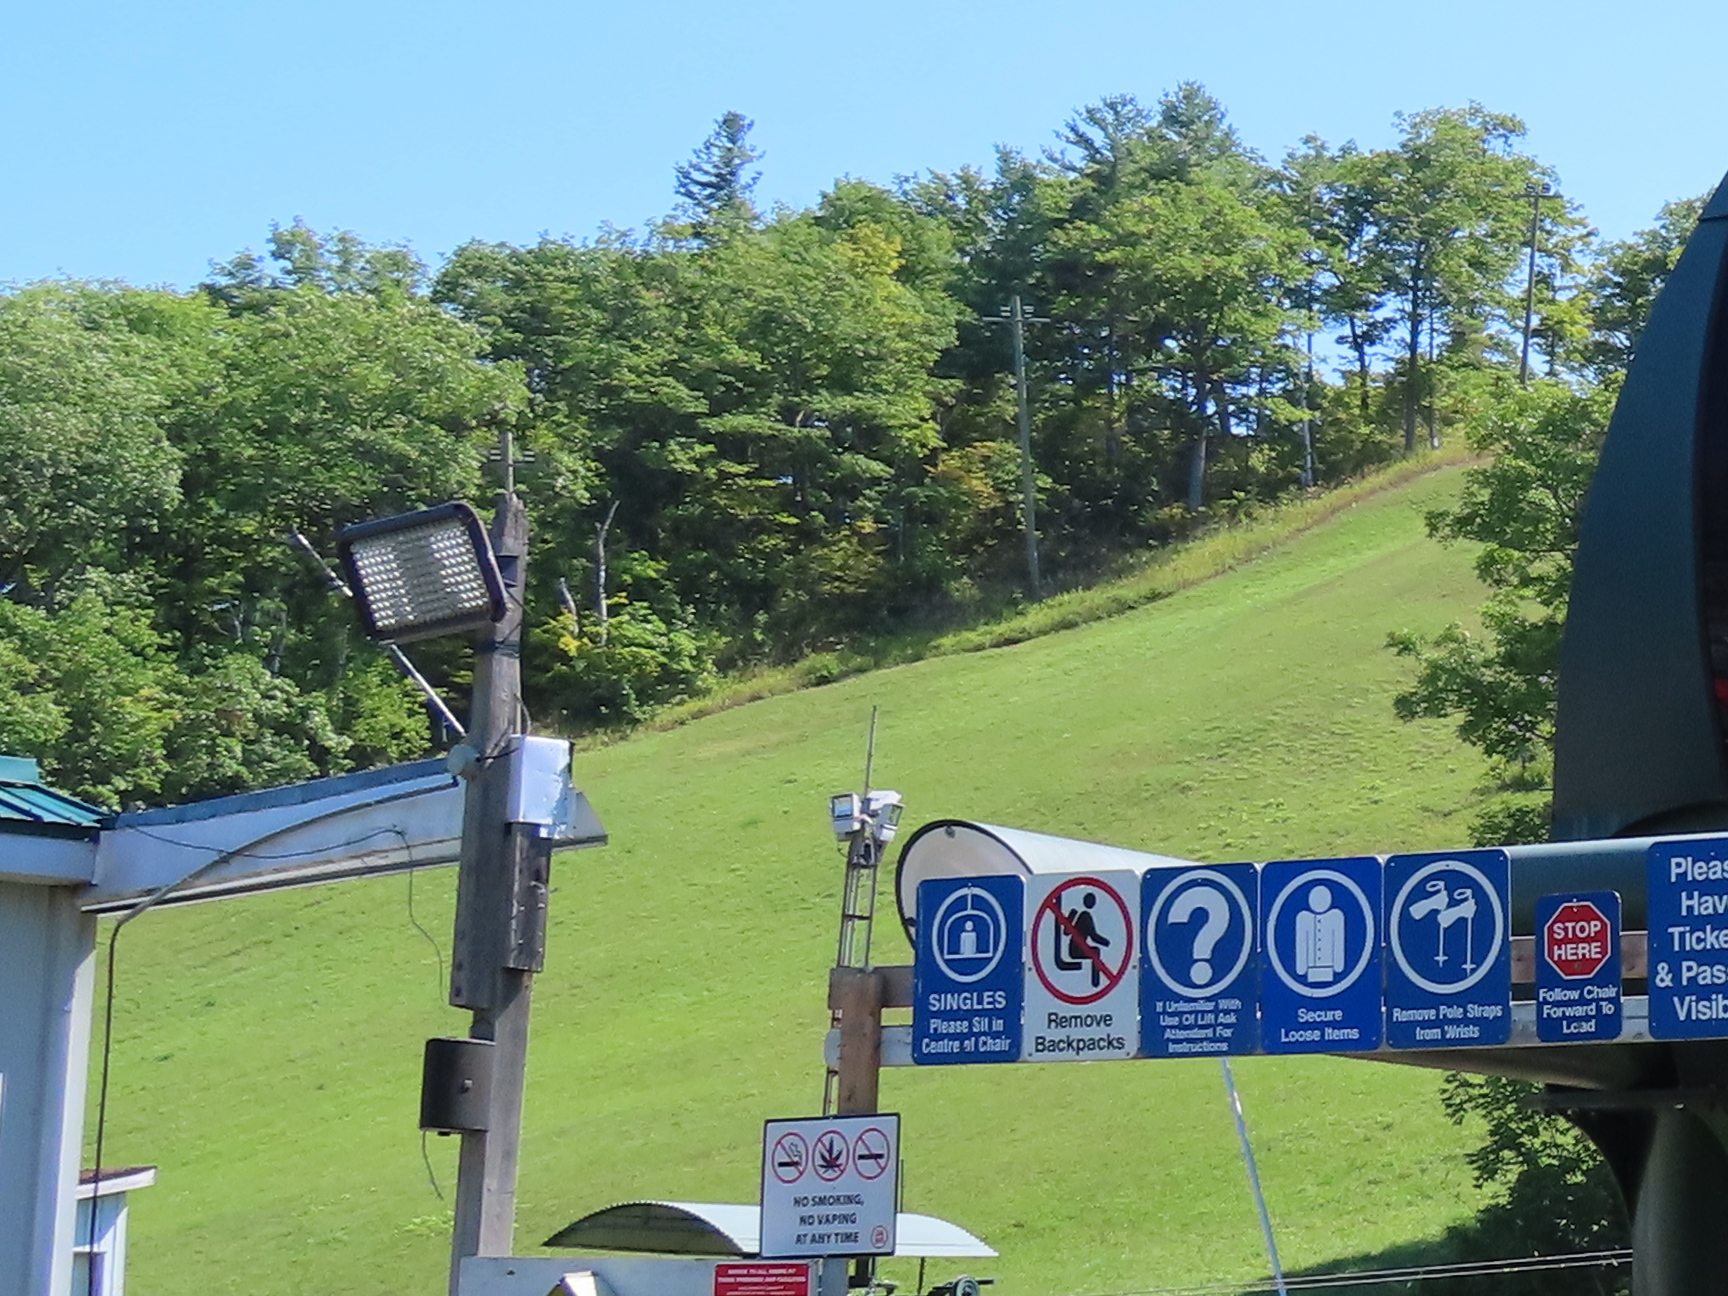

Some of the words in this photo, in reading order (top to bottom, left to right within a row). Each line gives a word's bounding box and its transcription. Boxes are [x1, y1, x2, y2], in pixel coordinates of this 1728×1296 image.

[1553, 921, 1601, 939] STOP
[1553, 942, 1602, 961] HERE
[1655, 962, 1673, 988] &
[928, 991, 1007, 1011] SINGLES
[1539, 988, 1579, 1002] Follow
[1583, 984, 1618, 1000] Chair
[1297, 1008, 1343, 1022] Secure
[1392, 1007, 1436, 1022] Remove
[1439, 1005, 1464, 1019] Pole
[1467, 1004, 1503, 1020] Straps
[1543, 1003, 1596, 1018] Forward
[1600, 1002, 1615, 1016] To
[929, 1017, 968, 1034] Please
[972, 1016, 989, 1032] Sit
[992, 1016, 1004, 1032] in
[1047, 1012, 1113, 1029] Remove
[1160, 1015, 1180, 1026] Use
[1183, 1014, 1195, 1025] Of
[1198, 1014, 1215, 1025] Lift
[1217, 1013, 1237, 1024] Ask
[1563, 1020, 1596, 1034] Load
[1216, 1026, 1233, 1038] For
[1281, 1028, 1320, 1042] Loose
[1325, 1027, 1360, 1040] Items
[1416, 1026, 1441, 1040] from
[1445, 1025, 1480, 1039] Wrists
[922, 1037, 960, 1054] Centre
[963, 1036, 976, 1052] of
[979, 1035, 1012, 1052] Chair
[1035, 1034, 1125, 1055] Backpacks
[1168, 1041, 1228, 1052] Instructions
[793, 1195, 809, 1207] NO
[799, 1214, 815, 1226] NO
[817, 1212, 857, 1225] VAPING
[795, 1232, 809, 1245] AT
[810, 1232, 833, 1244] ANY
[834, 1231, 860, 1244] TIME
